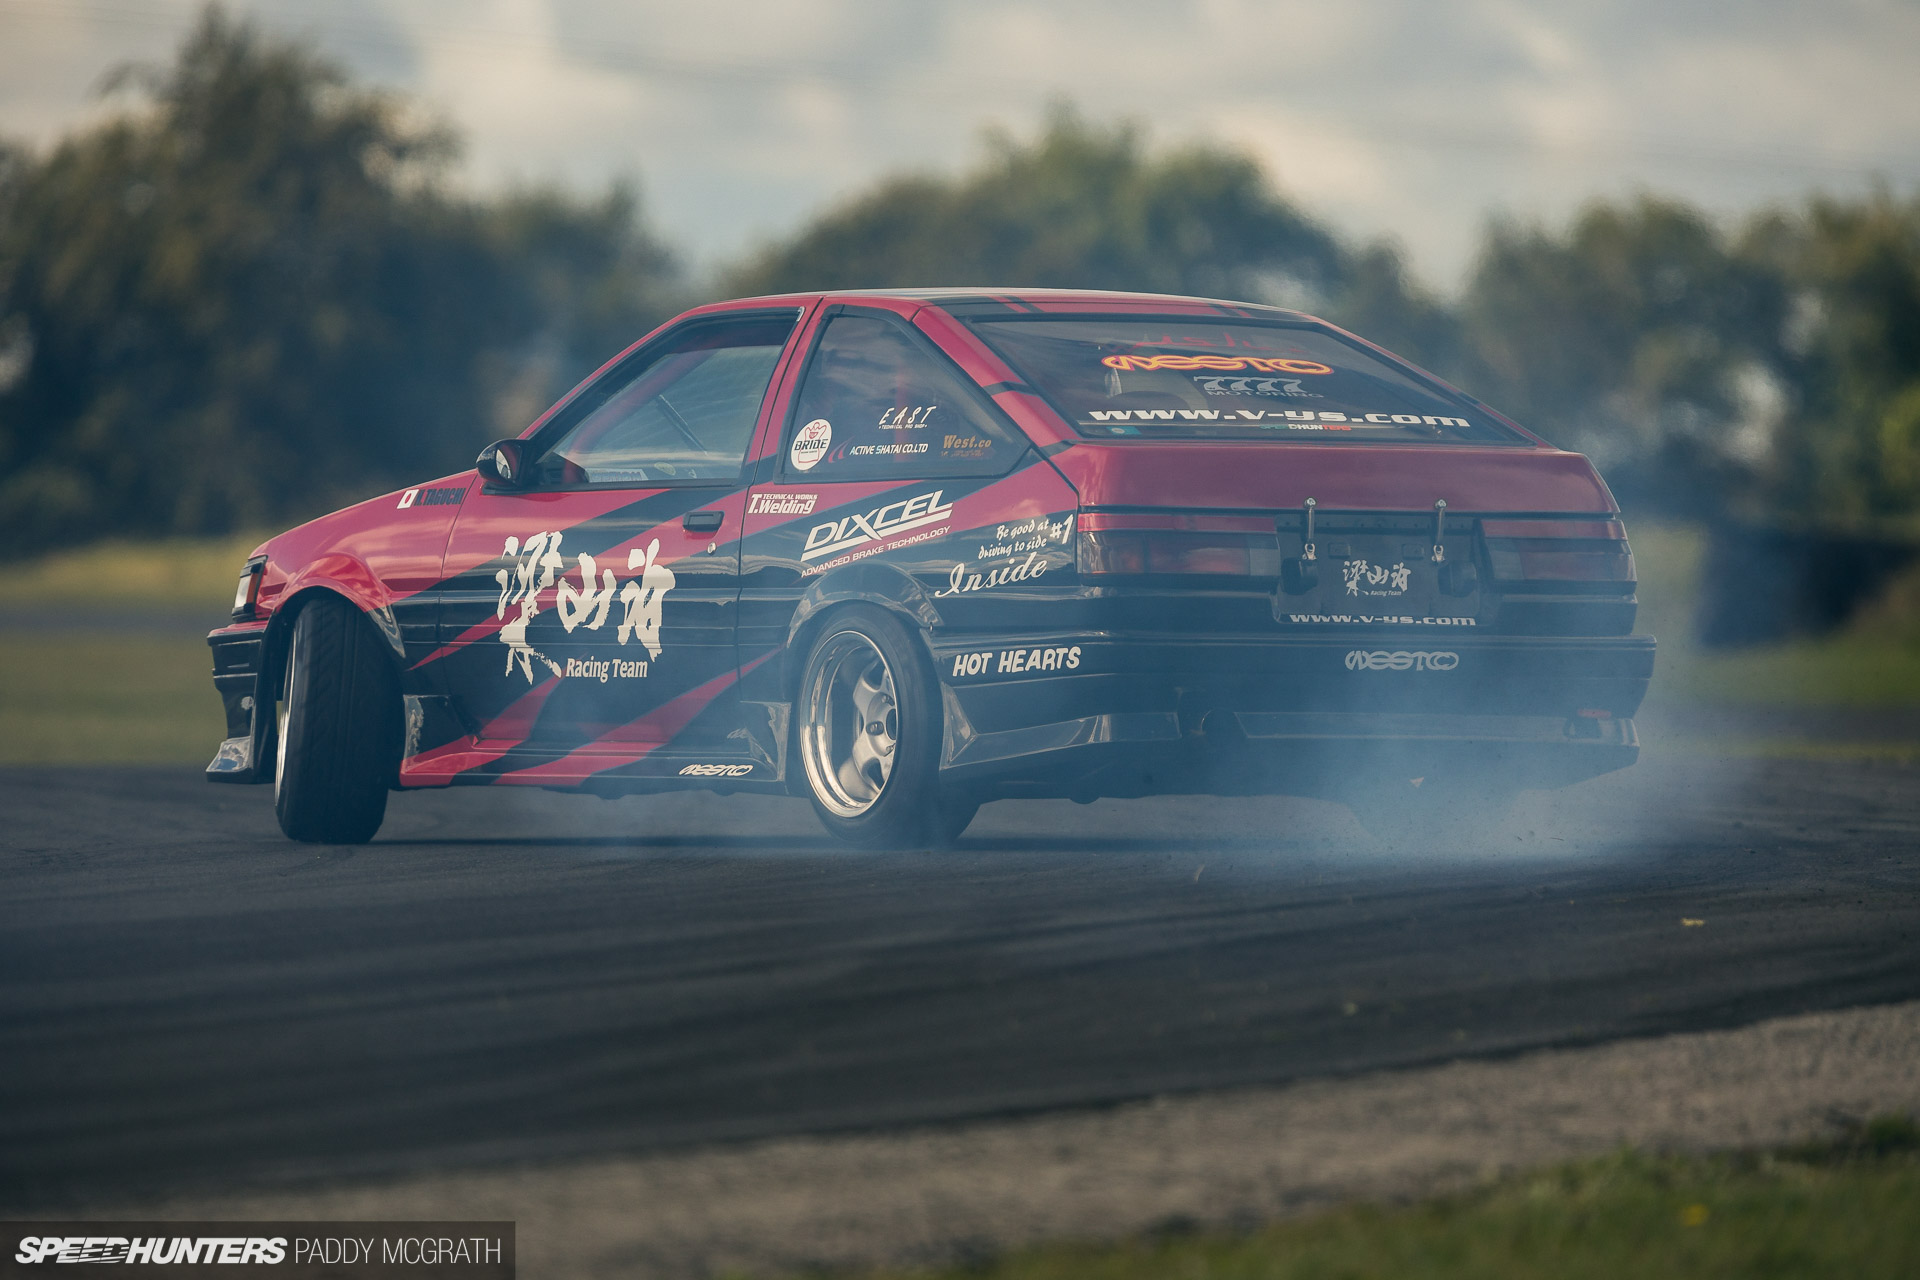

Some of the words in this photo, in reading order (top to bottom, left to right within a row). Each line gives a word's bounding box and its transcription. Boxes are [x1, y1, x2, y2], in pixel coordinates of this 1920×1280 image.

[1207, 390, 1324, 399] MOTORING
[1088, 409, 1470, 427] www.v-ys.com
[794, 439, 829, 451] BRIDE
[849, 445, 876, 456] ACTIVE
[875, 444, 902, 455] SHATAI
[943, 434, 992, 449] West.co
[747, 493, 816, 514] T.Welding
[803, 489, 954, 551] DIXCEL
[996, 524, 1010, 540] Be
[1010, 519, 1036, 539] good
[1036, 518, 1050, 532] at
[1050, 513, 1074, 545] #1
[801, 555, 850, 578] ADVANCED
[852, 545, 884, 561] BRAKE
[887, 525, 951, 551] TECHNOLOGY
[977, 542, 1013, 560] driving
[1014, 540, 1026, 552] to
[1025, 535, 1048, 551] side
[934, 551, 1048, 598] Inside
[1289, 614, 1477, 626] www.v-ys.com
[565, 655, 609, 683] Racing
[611, 658, 649, 679] Team
[952, 652, 994, 677] HOT
[997, 646, 1082, 674] HEARTS
